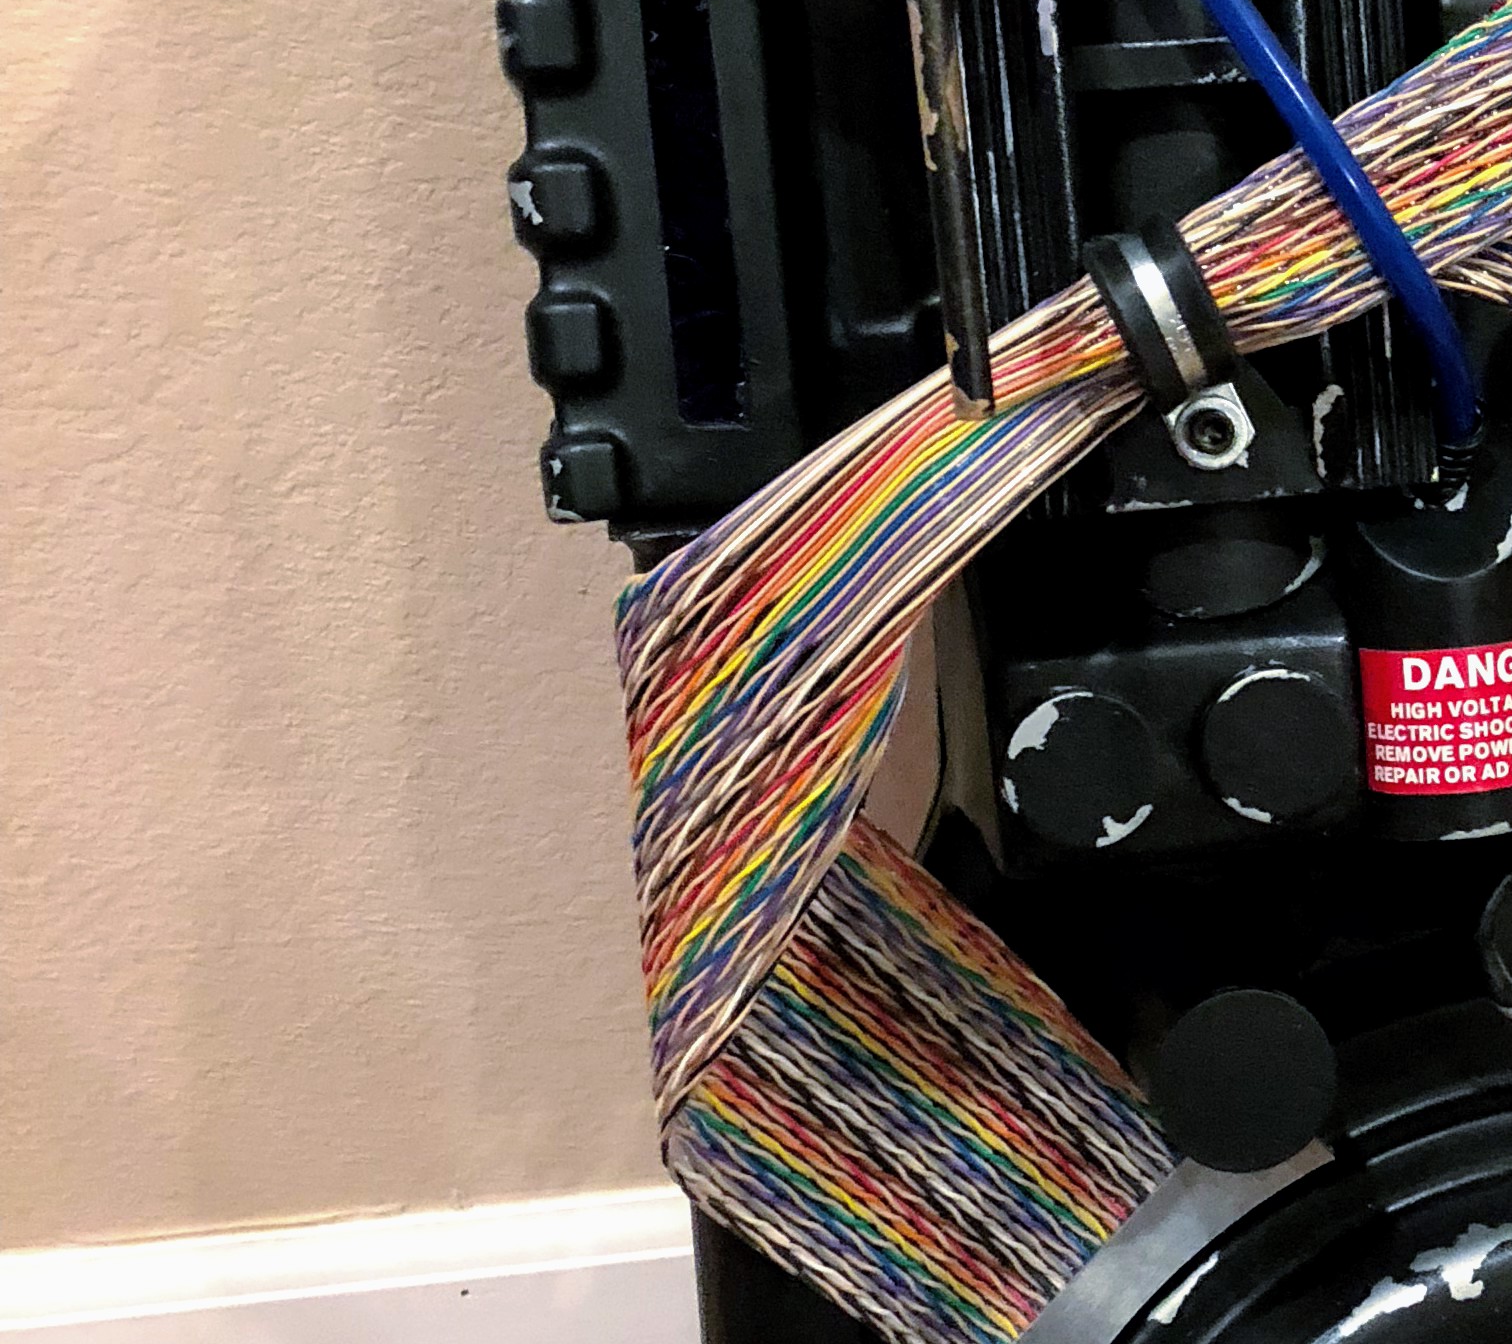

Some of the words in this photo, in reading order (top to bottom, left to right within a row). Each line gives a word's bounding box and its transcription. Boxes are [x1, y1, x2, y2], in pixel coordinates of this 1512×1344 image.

[1390, 701, 1442, 720] HIGH
[1367, 722, 1455, 742] ELECTRIC
[1375, 744, 1455, 763] REMOVE
[1374, 765, 1441, 784] REPAIR
[1444, 765, 1477, 784] OR
